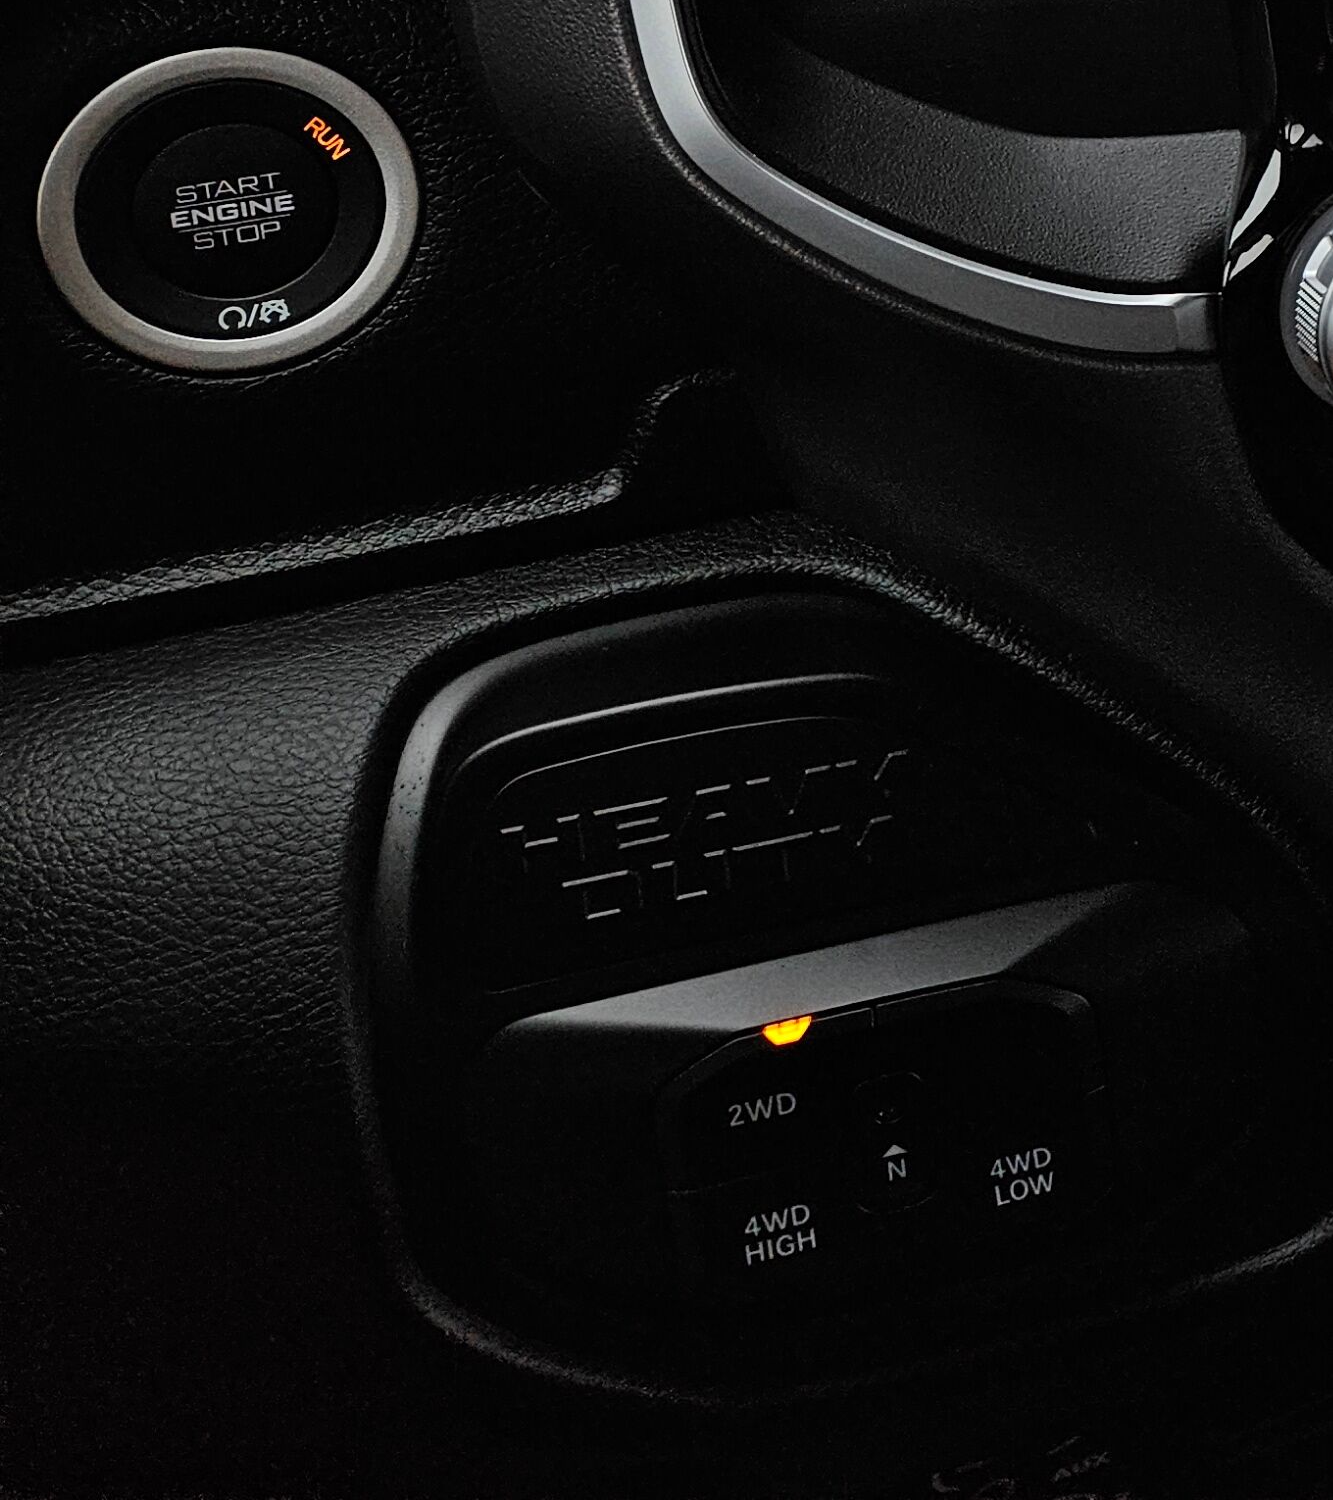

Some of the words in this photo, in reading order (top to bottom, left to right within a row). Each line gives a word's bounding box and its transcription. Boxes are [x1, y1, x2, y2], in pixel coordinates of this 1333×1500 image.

[304, 116, 351, 161] RUN
[176, 171, 282, 204] START
[170, 194, 295, 229] ENGINE
[194, 220, 282, 250] STOP
[727, 1092, 797, 1128] 2WD
[886, 1159, 908, 1182] N
[989, 1146, 1053, 1180] 4WD
[994, 1171, 1055, 1207] LOW
[744, 1203, 811, 1238] 4WD
[744, 1228, 818, 1267] HIGH
